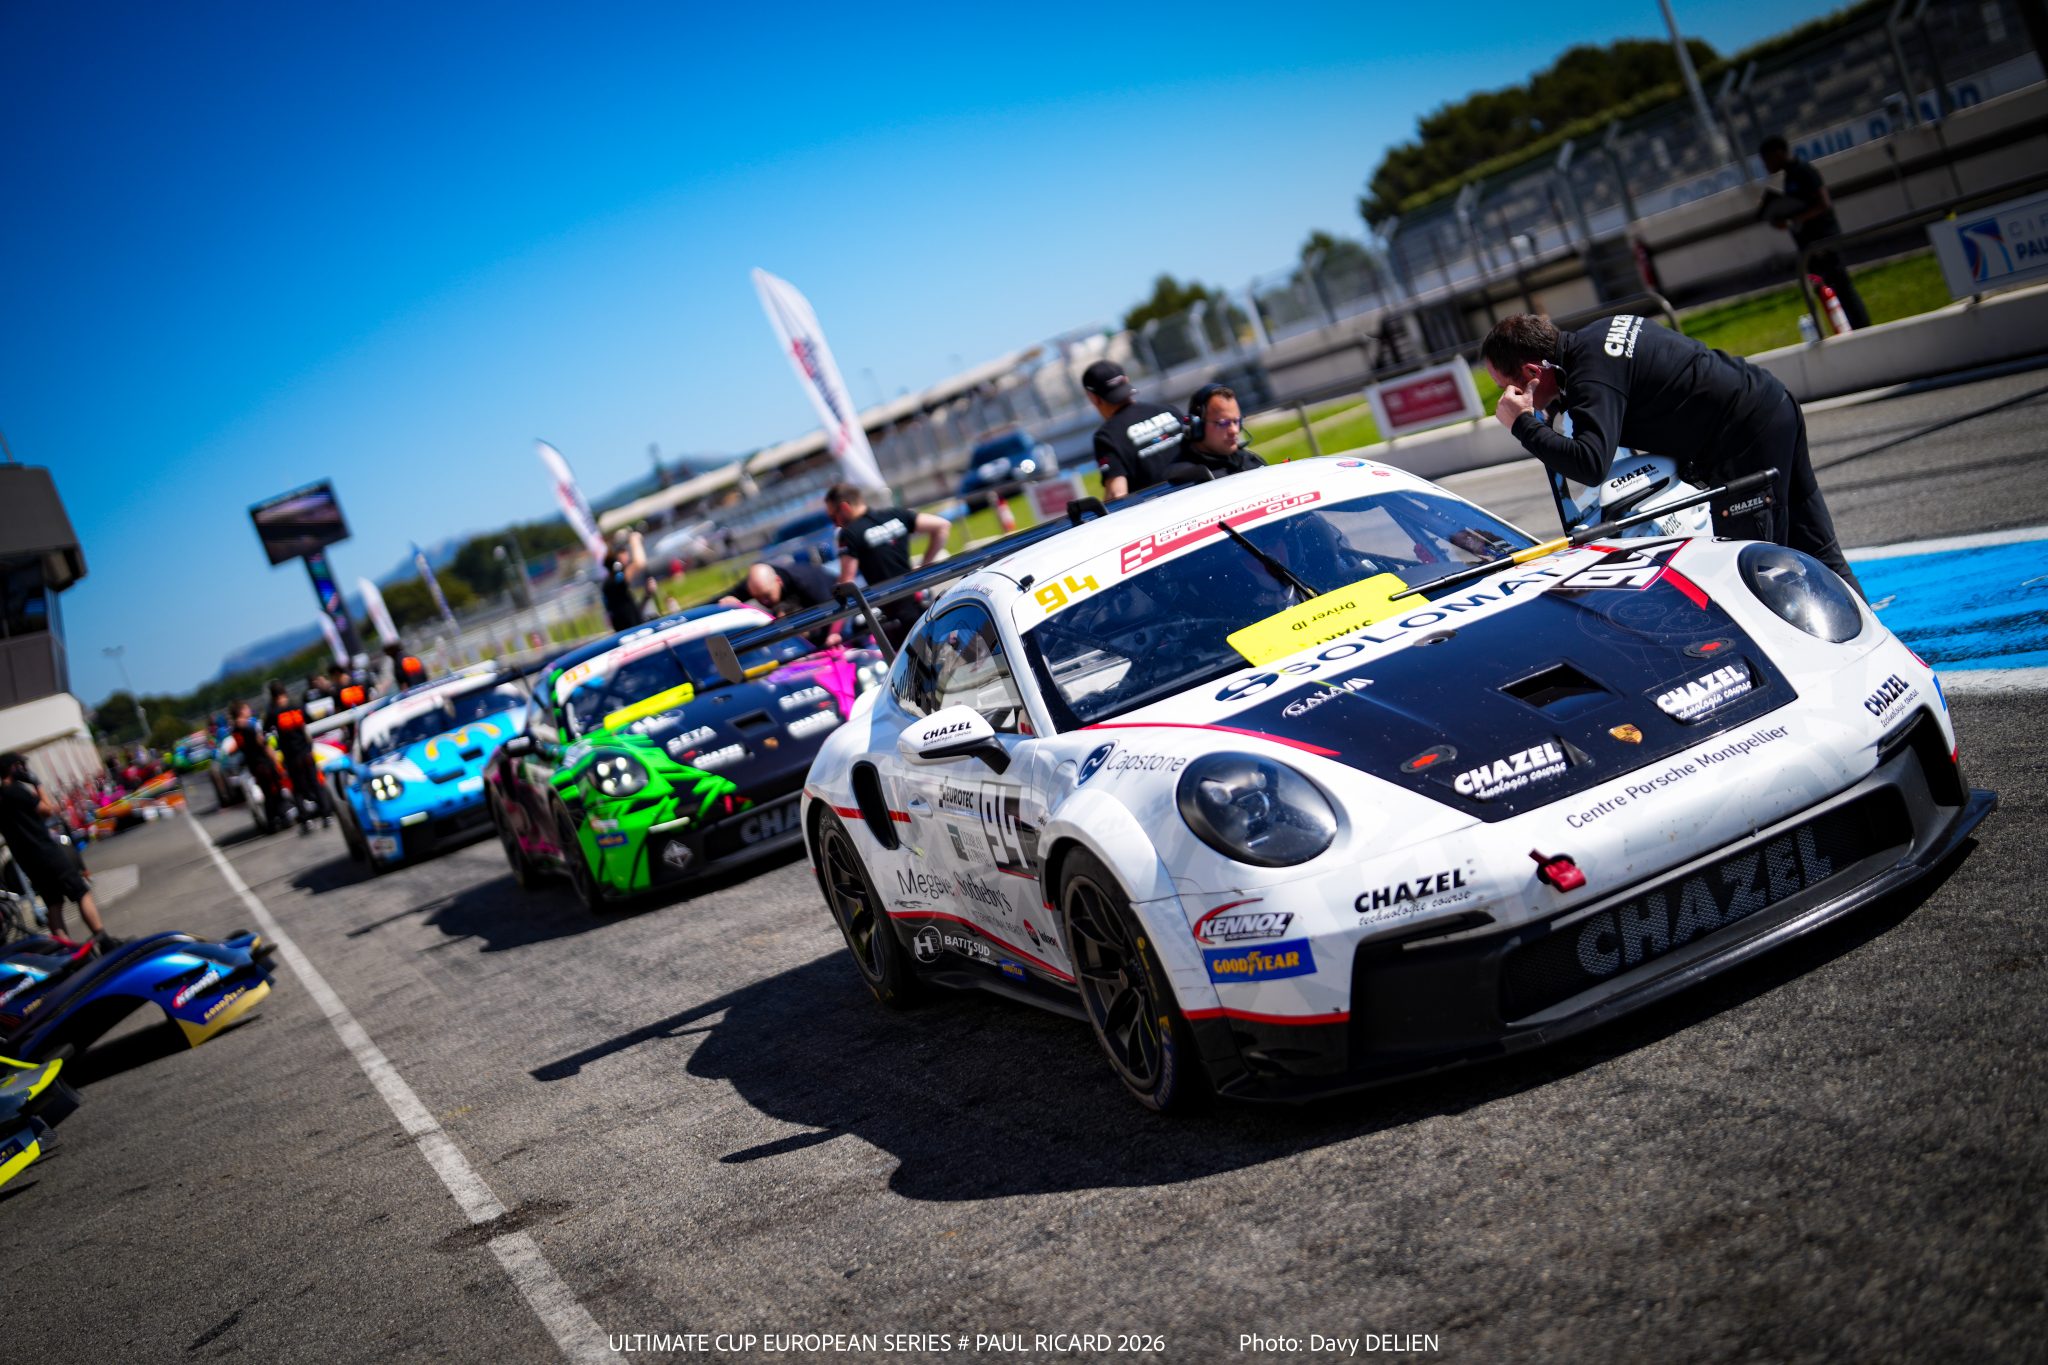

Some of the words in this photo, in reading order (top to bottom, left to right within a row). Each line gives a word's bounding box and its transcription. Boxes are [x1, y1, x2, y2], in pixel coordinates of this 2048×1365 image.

[1611, 463, 1656, 488] CHAZEL
[1265, 493, 1315, 514] CUP
[1729, 496, 1763, 512] CHAZEL
[1160, 531, 1179, 543] GT
[1187, 491, 1292, 531] ENDURANCE
[1034, 574, 1100, 614] 94
[1278, 567, 1563, 676] SOLOMAT
[1311, 601, 1357, 622] Driver
[1291, 620, 1308, 631] ID
[1657, 665, 1746, 714] CHAZEL
[1723, 680, 1752, 699] course
[1863, 673, 1910, 717] CHAZEL
[922, 721, 972, 741] CHAZEL
[1106, 748, 1187, 781] Capstone
[1454, 742, 1564, 796] CHAZEL
[1529, 761, 1567, 782] course
[1565, 793, 1628, 829] Centre
[1624, 762, 1698, 800] Porsche
[1694, 725, 1790, 769] Montpellier
[945, 786, 974, 809] EUROTEC
[1354, 868, 1467, 914] CHAZEL
[1431, 890, 1473, 908] course
[1577, 825, 1833, 976] CHAZEL
[1199, 912, 1288, 938] KENNOL
[1212, 951, 1300, 976] GOODYEAR
